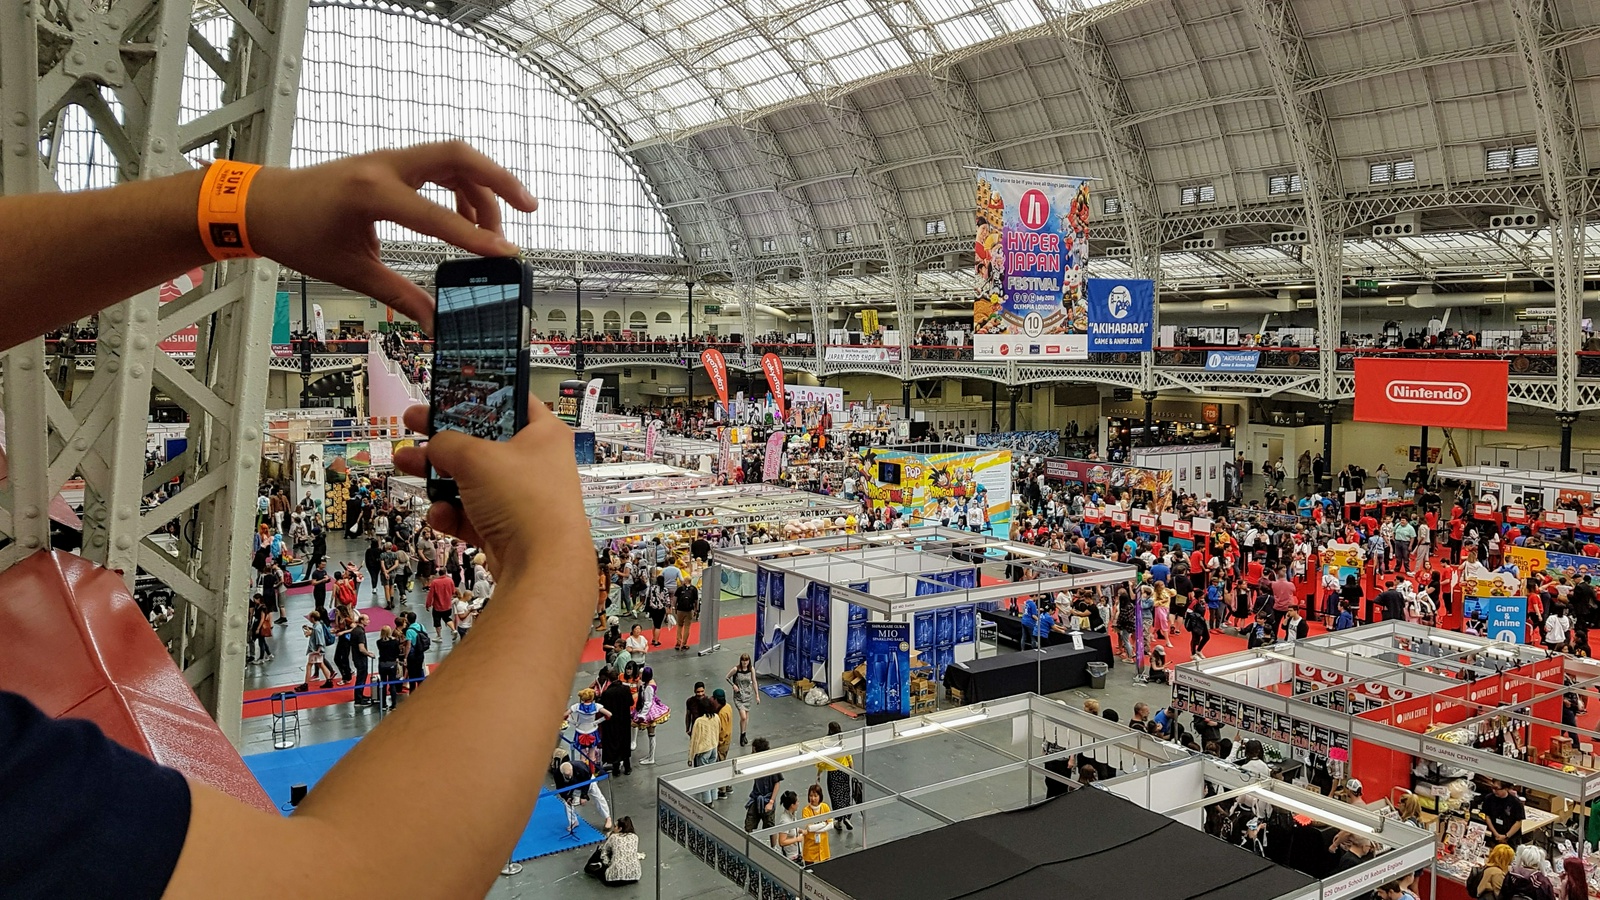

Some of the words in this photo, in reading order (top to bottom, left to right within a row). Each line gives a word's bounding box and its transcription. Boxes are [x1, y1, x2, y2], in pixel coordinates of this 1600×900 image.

[224, 170, 243, 194] SUN
[1008, 231, 1060, 252] HYPER
[1008, 252, 1060, 274] JAPAN
[1008, 276, 1060, 291] FESTIVAL
[1028, 317, 1039, 329] 10
[1393, 385, 1463, 400] Nintendo
[905, 465, 921, 478] POP
[868, 481, 890, 500] DRAGON
[930, 486, 954, 498] DRAGON
[733, 515, 765, 523] ARTBOX
[800, 510, 830, 518] ARTBOX
[662, 520, 698, 531] ARTBOX
[1530, 558, 1540, 570] 2
[1541, 670, 1549, 679] JAPAN
[1549, 666, 1561, 677] CENTRE
[1194, 678, 1211, 686] TRADING
[1510, 679, 1518, 689] JAPAN
[1476, 689, 1486, 700] JAPAN
[1487, 685, 1498, 696] CENTRE
[1441, 701, 1452, 711] JAPAN
[1403, 710, 1414, 722] JAPAN
[1414, 707, 1428, 719] CENTRE
[1438, 749, 1455, 757] JAPAN
[1456, 754, 1479, 764] CENTRE
[1334, 884, 1347, 893] Ohara
[1348, 878, 1362, 887] School
[1364, 873, 1369, 881] Of
[1371, 868, 1386, 878] Ikebana
[1387, 860, 1404, 871] England
